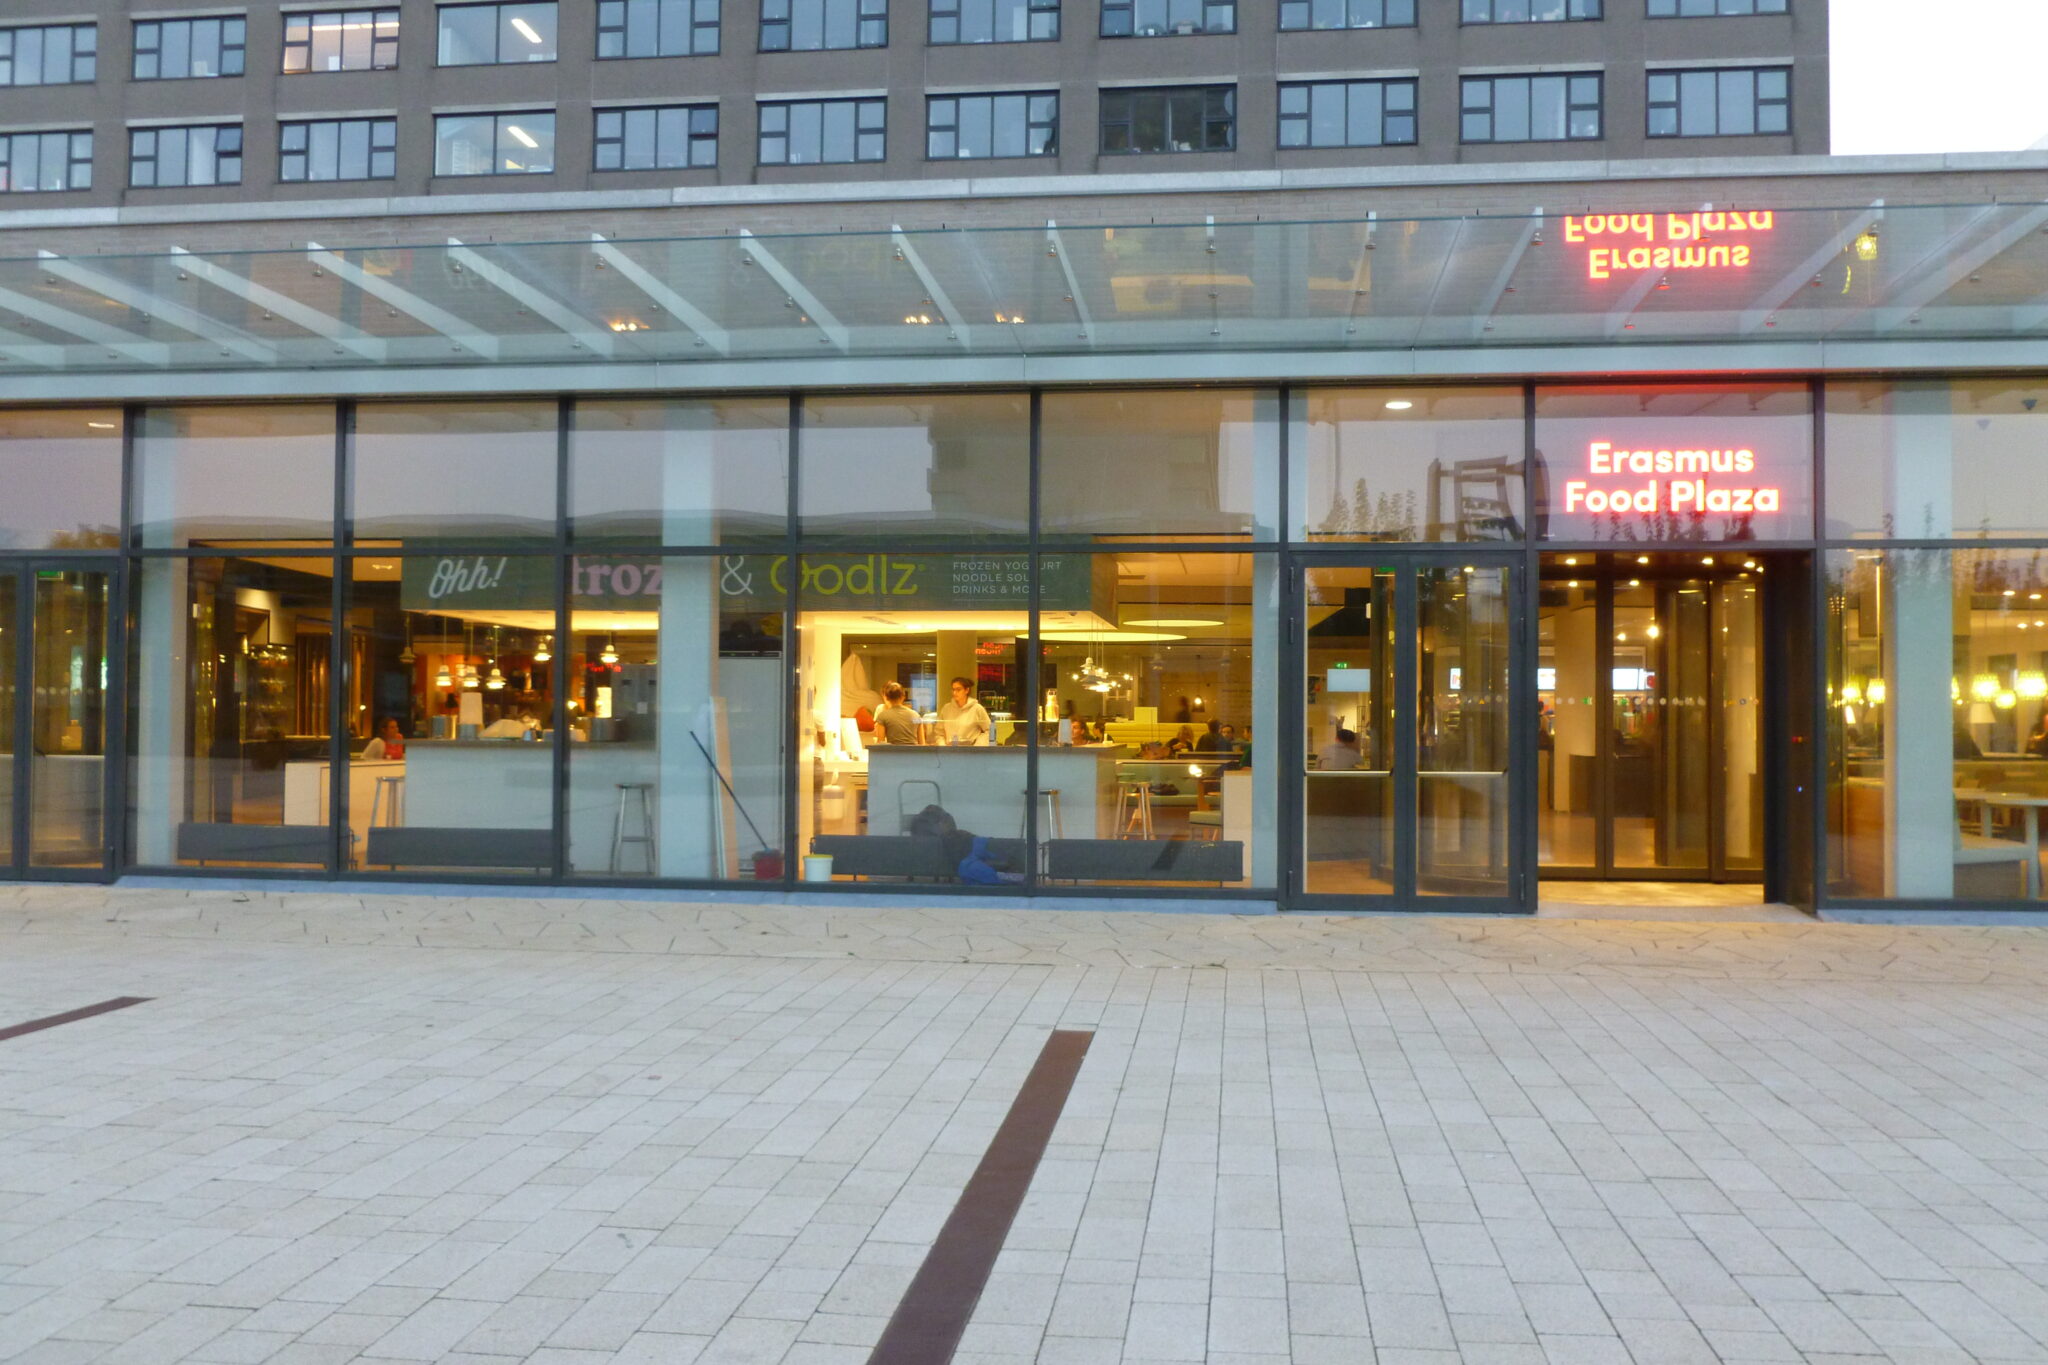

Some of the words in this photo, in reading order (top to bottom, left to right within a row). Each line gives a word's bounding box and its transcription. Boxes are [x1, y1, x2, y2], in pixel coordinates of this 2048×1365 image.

[1589, 442, 1755, 474] Erasmus
[1566, 479, 1657, 512] Food
[1670, 479, 1779, 512] Plaza
[428, 556, 507, 598] Ohh!
[720, 555, 754, 596] &
[953, 561, 1000, 571] FROZEN
[1004, 561, 1062, 571] YOGURT
[953, 573, 1002, 582] NOODLE
[953, 585, 996, 594] DRINKS
[1012, 585, 1046, 594] MOE
